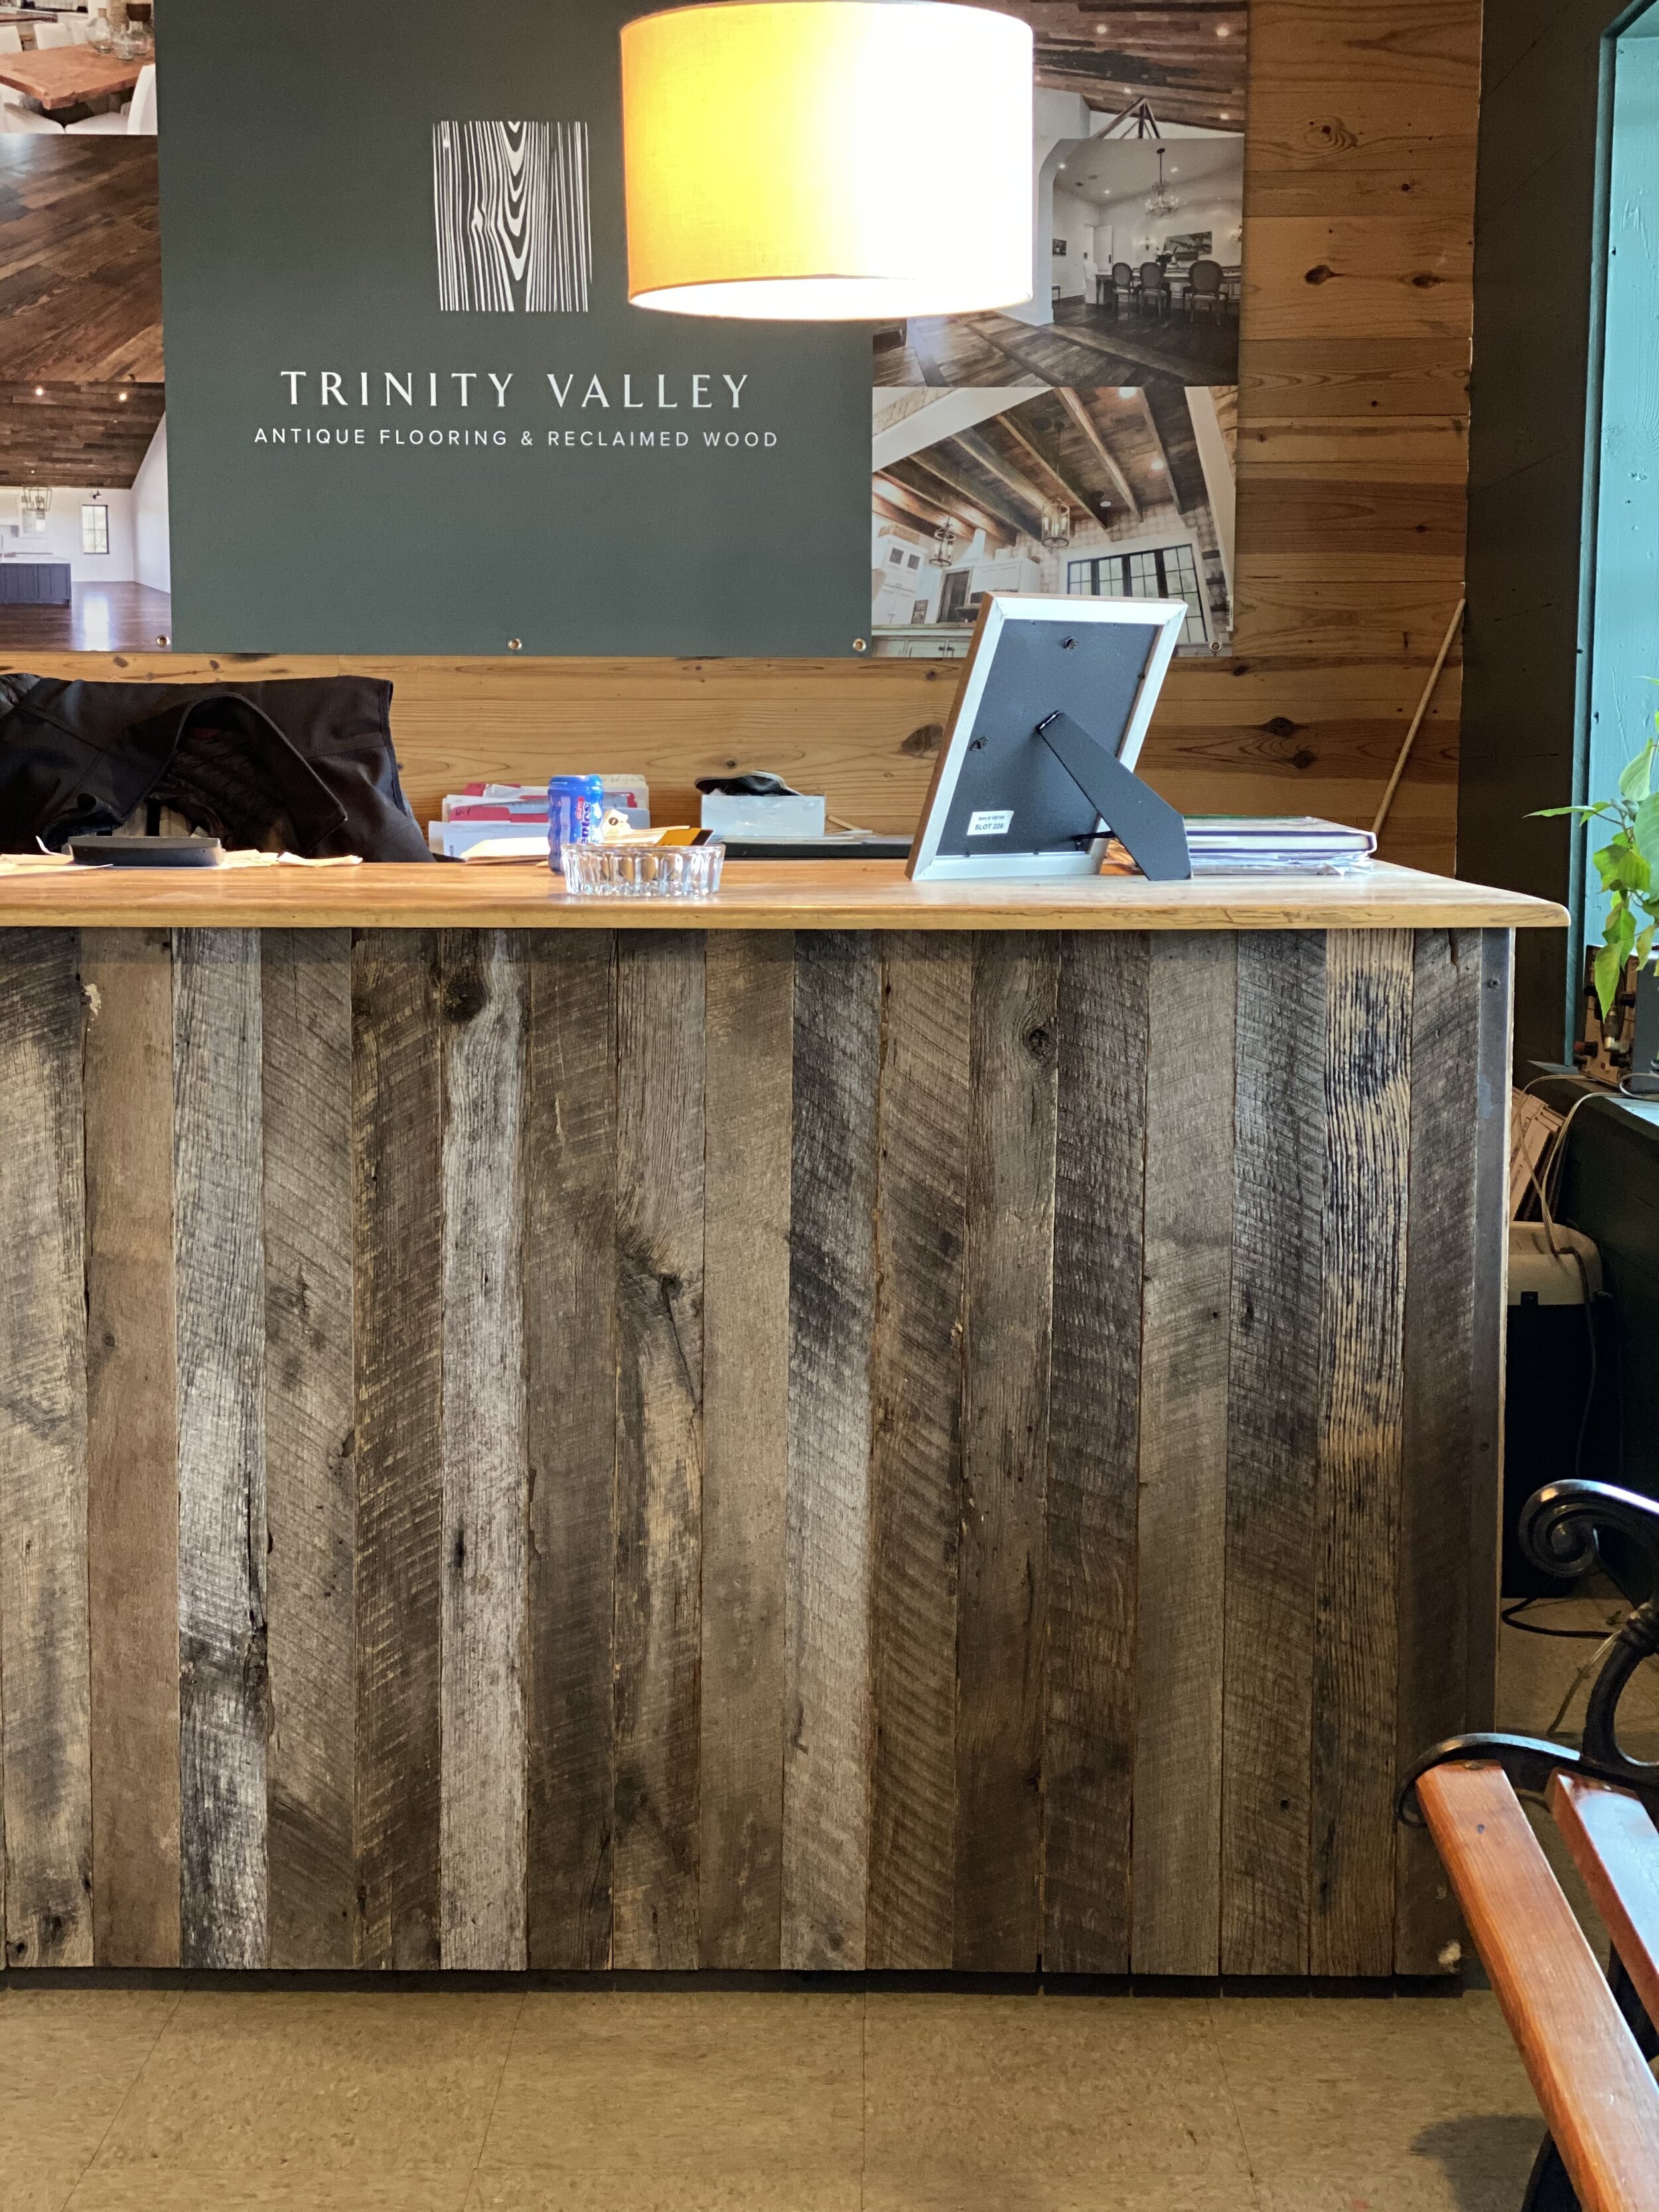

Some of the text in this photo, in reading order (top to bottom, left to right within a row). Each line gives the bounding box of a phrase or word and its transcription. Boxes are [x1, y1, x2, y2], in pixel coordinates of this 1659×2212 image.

[280, 371, 749, 409] TRINITY VALLEY
[254, 427, 778, 448] ANTIQUE FLOORING & RECLAIMED WOOD
[581, 802, 591, 844] entos
